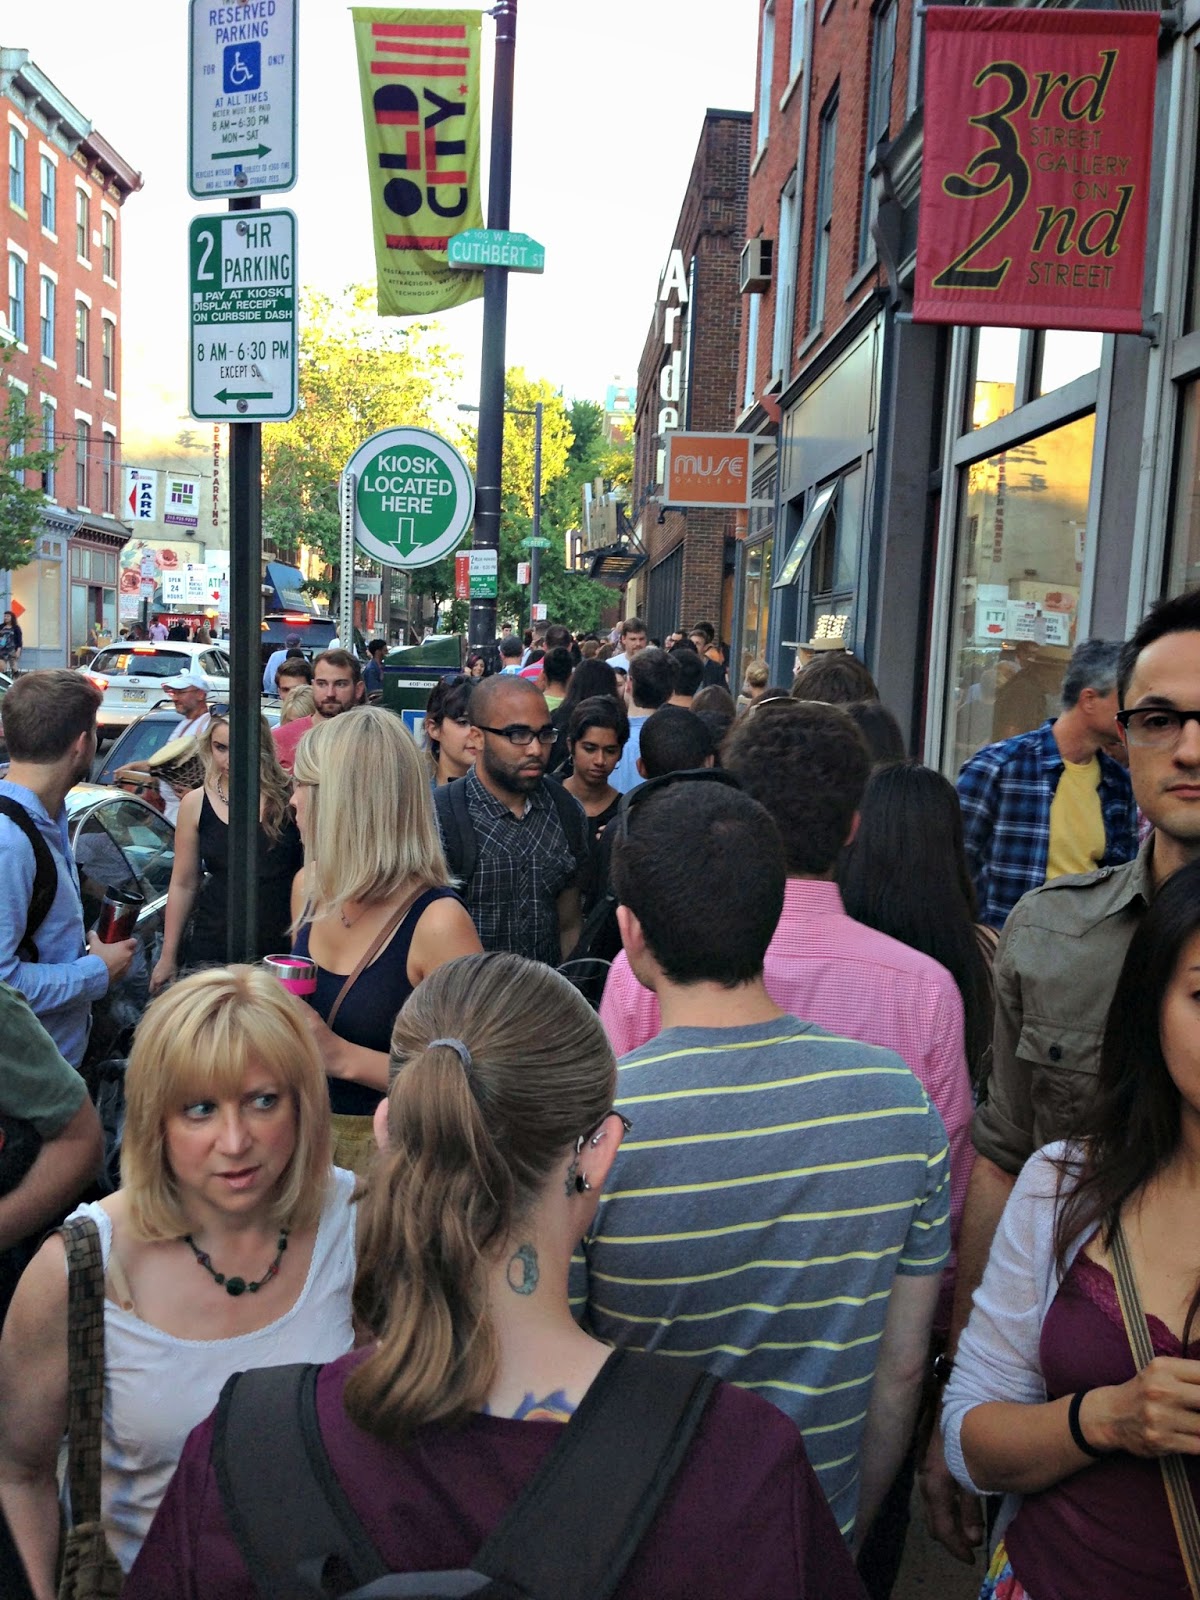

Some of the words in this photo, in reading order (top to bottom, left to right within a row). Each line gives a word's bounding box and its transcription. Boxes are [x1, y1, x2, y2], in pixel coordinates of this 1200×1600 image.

[209, 0, 276, 26] RESERVED
[215, 20, 269, 45] PARKING
[202, 64, 216, 76] FOR
[267, 54, 285, 67] ONLY
[212, 109, 230, 118] METER
[232, 106, 247, 115] MUST
[248, 105, 257, 113] BE
[259, 103, 272, 112] PAID
[215, 98, 224, 109] AT
[227, 95, 241, 107] ALL
[244, 92, 269, 105] TIMES
[211, 121, 217, 132] 8
[258, 114, 270, 126] PM
[1029, 126, 1104, 150] STREET
[1036, 152, 1131, 177] GALLERY
[1072, 181, 1108, 200] ON
[474, 231, 489, 239] 100
[493, 231, 504, 241] W
[196, 230, 215, 281] 2
[246, 222, 273, 249] HR
[452, 241, 528, 265] CUTHBERT
[224, 254, 290, 283] PARKING
[1028, 261, 1115, 288] STREET
[388, 279, 433, 287] ATTRACTIONS
[395, 289, 439, 297] TECHNOLOGY
[205, 291, 224, 301] PAY
[229, 289, 243, 300] AT
[247, 287, 285, 299] KIOSK
[193, 302, 232, 312] DISPLAY
[236, 300, 278, 310] RECEIPT
[193, 314, 208, 323] ON
[211, 312, 261, 322] CURBSIDE
[264, 310, 293, 320] DASH
[197, 343, 205, 362] 8
[272, 340, 289, 360] PM
[220, 365, 248, 380] EXCEPT
[377, 455, 440, 475] KIOSK
[673, 454, 744, 477] MUSE
[363, 475, 453, 497] LOCATED
[140, 483, 153, 518] PARK
[212, 469, 220, 527] PARKING
[381, 495, 433, 515] HERE
[470, 555, 475, 564] 2
[170, 584, 179, 592] 24
